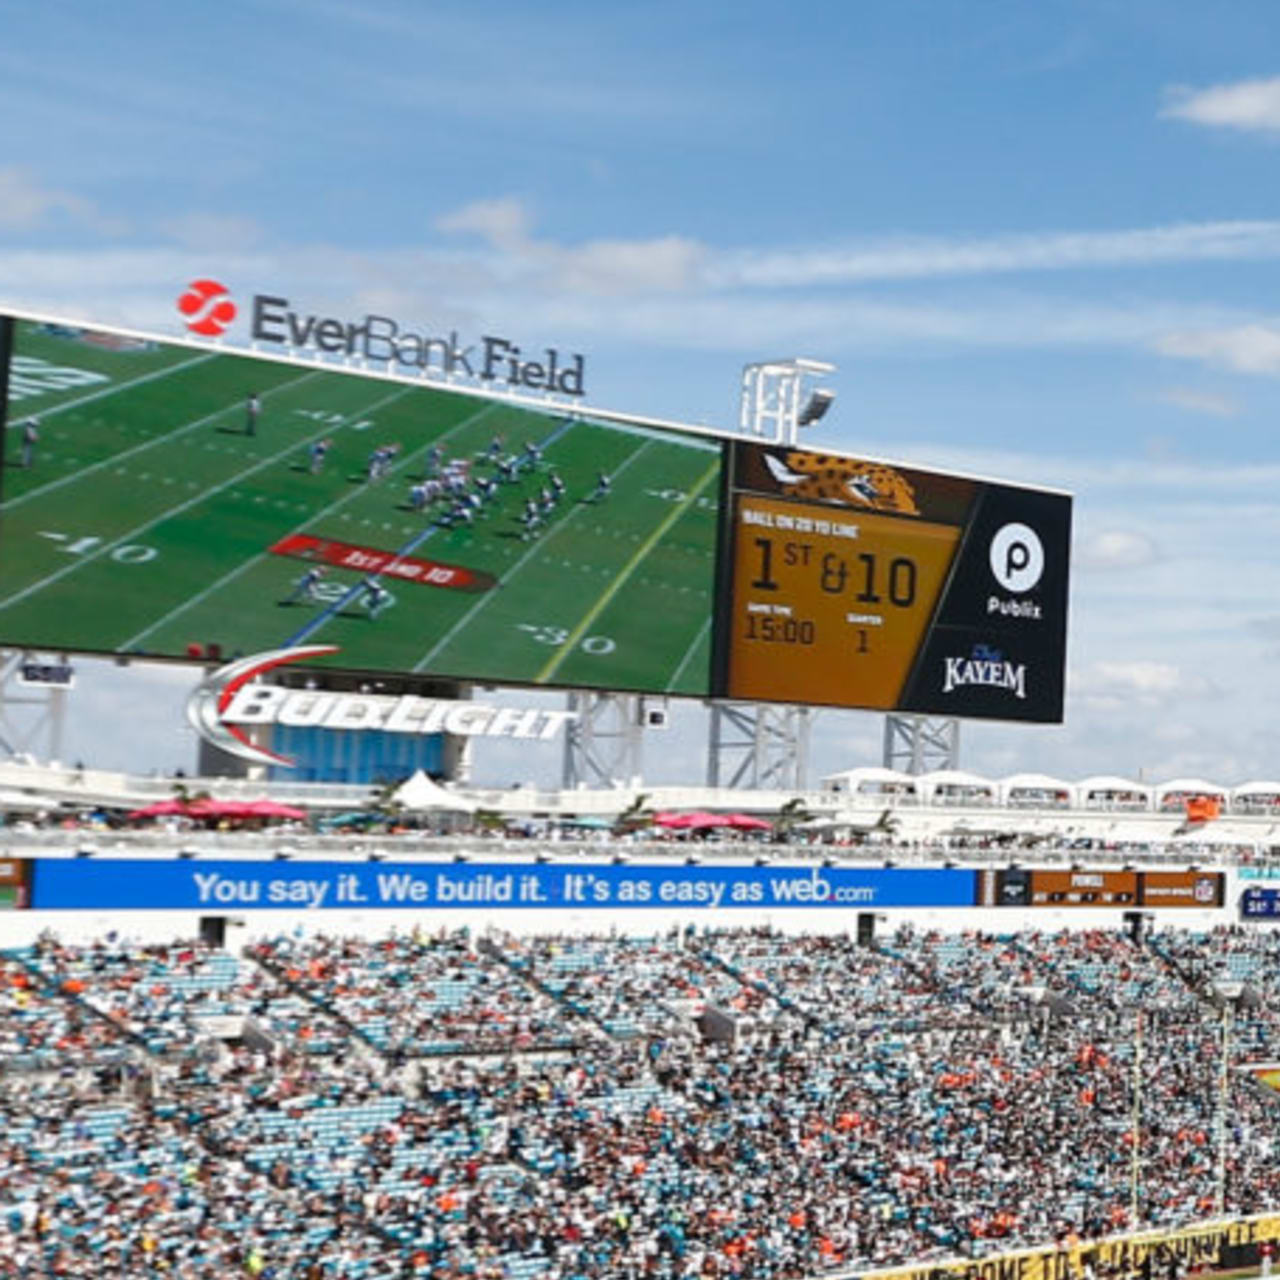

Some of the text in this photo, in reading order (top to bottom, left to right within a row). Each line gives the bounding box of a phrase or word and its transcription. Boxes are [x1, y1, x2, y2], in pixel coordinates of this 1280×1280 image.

[252, 295, 586, 396] EverBank Field
[855, 552, 917, 608] 10
[986, 596, 1042, 619] Publix
[744, 616, 815, 646] 15:00
[942, 656, 1027, 699] KAYEM
[386, 694, 580, 739] LIGHT
[194, 868, 876, 909] You say it. We build it. It's as easy as web.com
